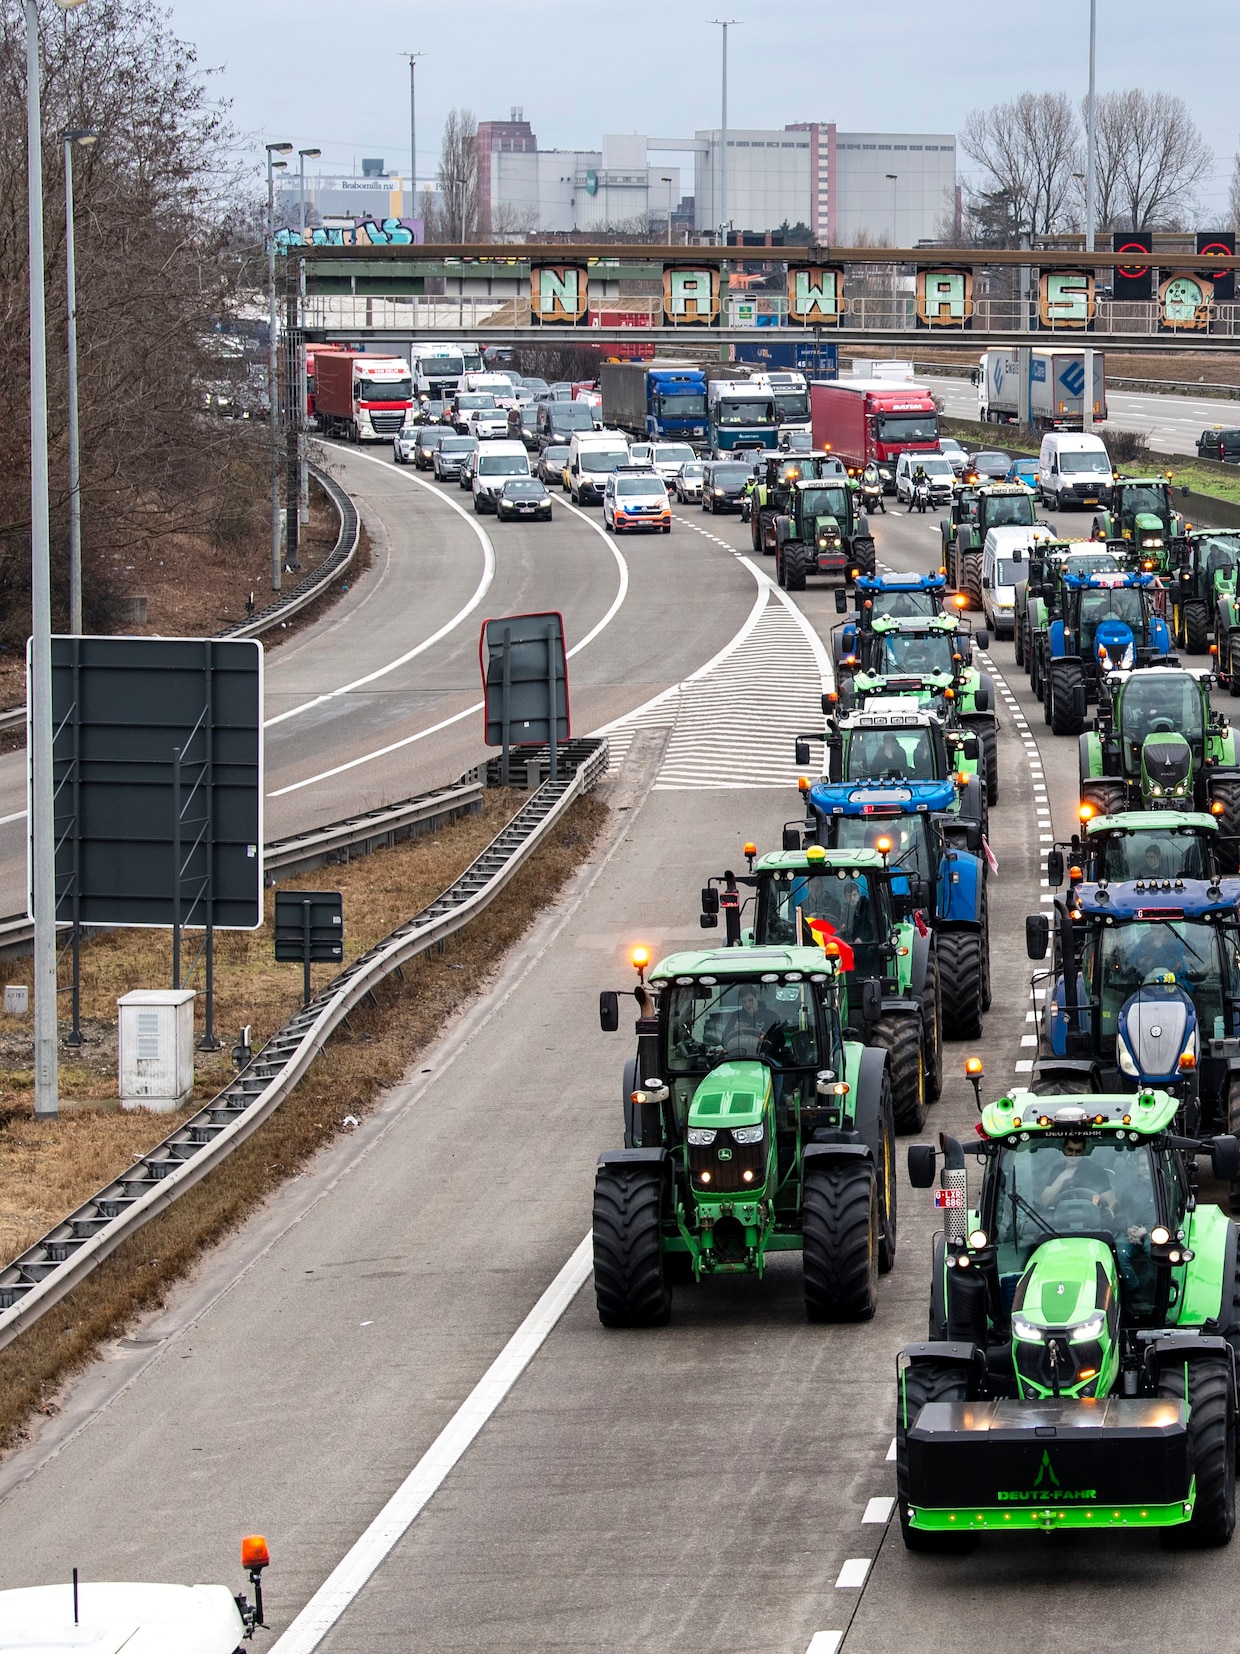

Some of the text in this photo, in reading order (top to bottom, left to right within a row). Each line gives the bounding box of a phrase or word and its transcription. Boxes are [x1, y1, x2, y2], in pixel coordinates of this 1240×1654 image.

[342, 181, 381, 190] Brabomills
[892, 403, 923, 411] BATIM
[945, 1199, 961, 1207] 686
[997, 1489, 1097, 1501] DEUTZ-FAHR
